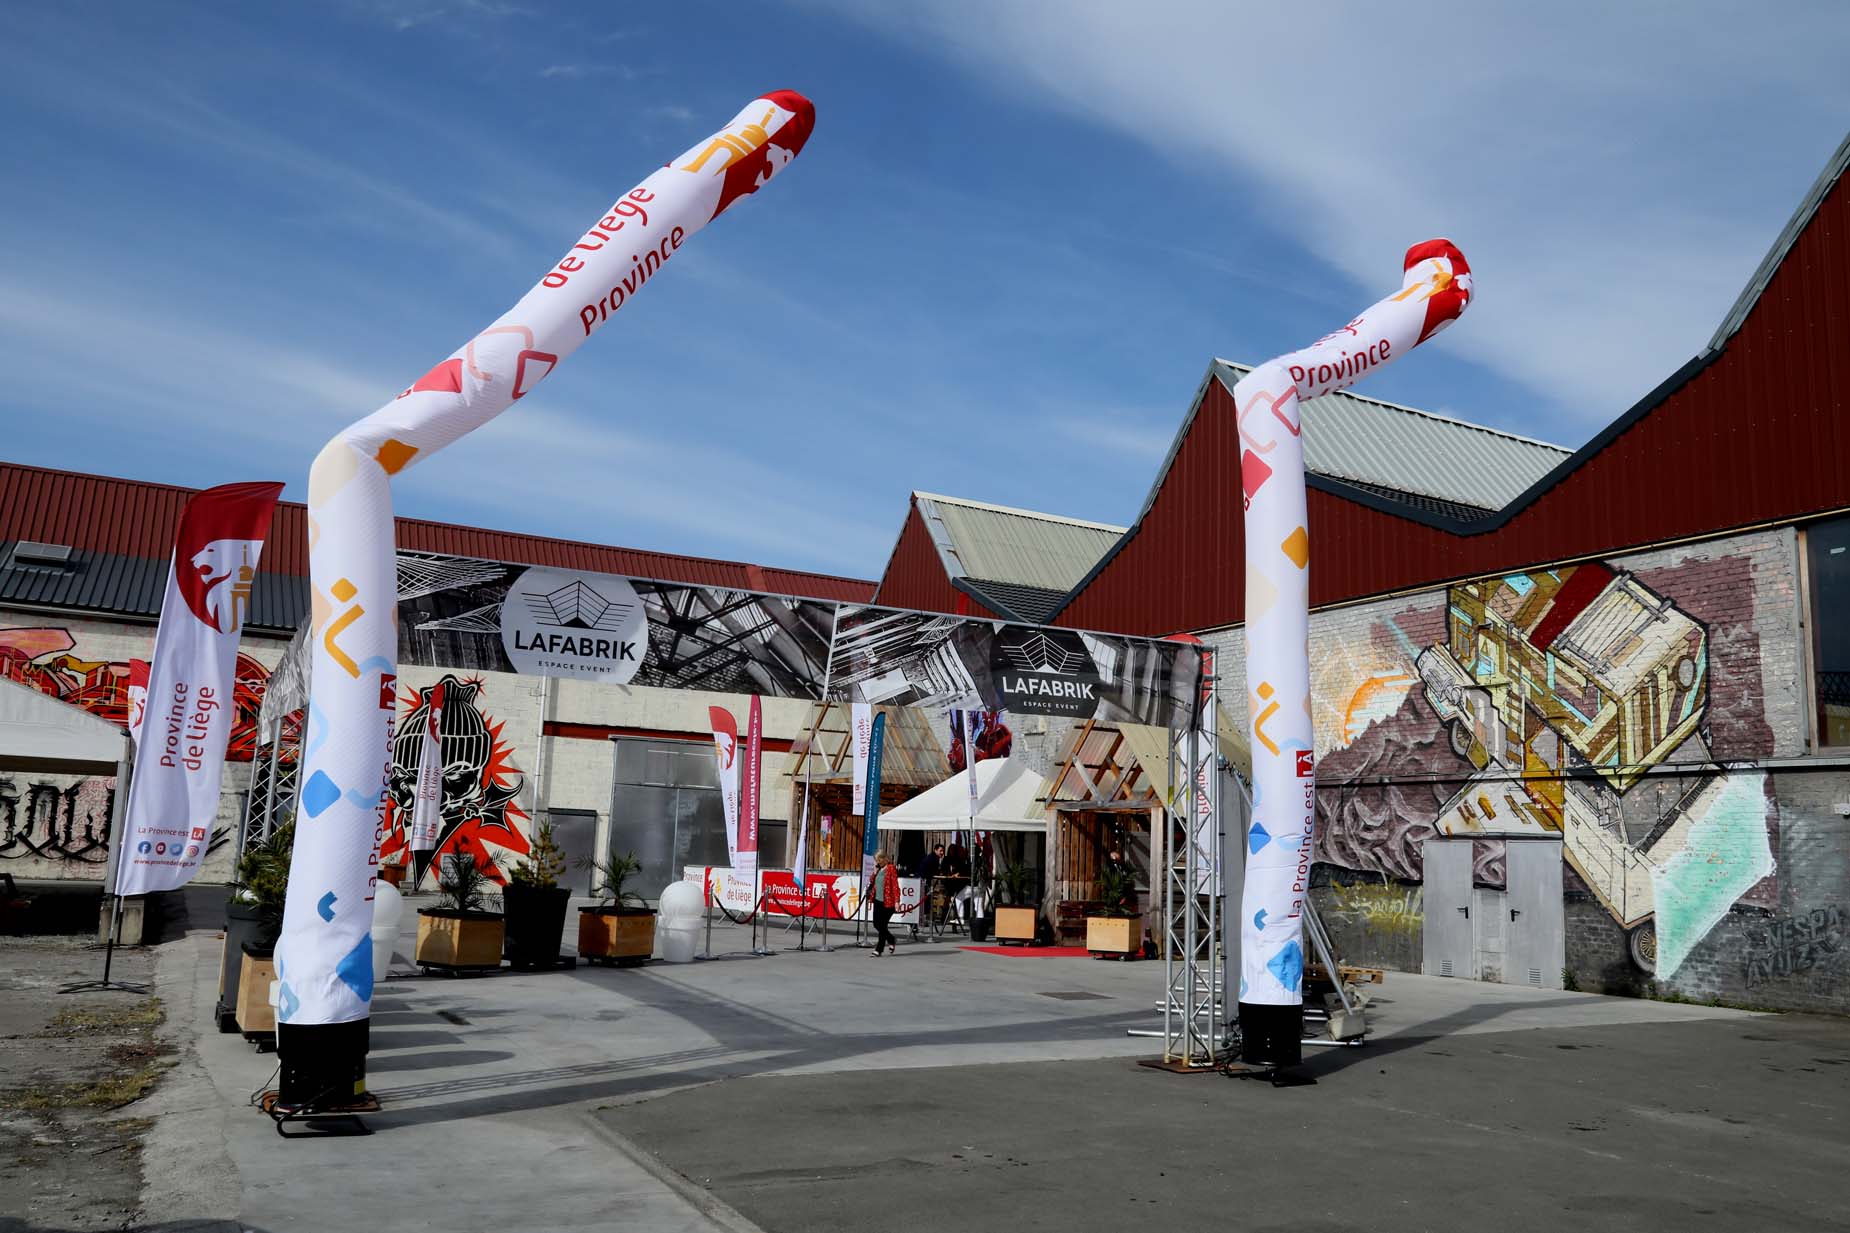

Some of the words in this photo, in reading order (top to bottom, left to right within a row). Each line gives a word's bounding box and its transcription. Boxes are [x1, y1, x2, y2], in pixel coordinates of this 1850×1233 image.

[579, 225, 685, 336] Province
[1289, 338, 1391, 388] Province
[514, 630, 637, 661] LAFABRIK
[538, 660, 574, 670] ESPACE
[580, 665, 611, 673] EVENT
[1002, 676, 1095, 700] LAFABRIK
[160, 682, 188, 768] Province
[186, 686, 219, 742] Liège
[182, 745, 204, 771] de
[1304, 781, 1313, 809] est
[368, 761, 393, 866] Province
[1292, 815, 1312, 892] Province
[772, 884, 798, 896] Province
[798, 887, 811, 897] et
[1288, 898, 1301, 919] La
